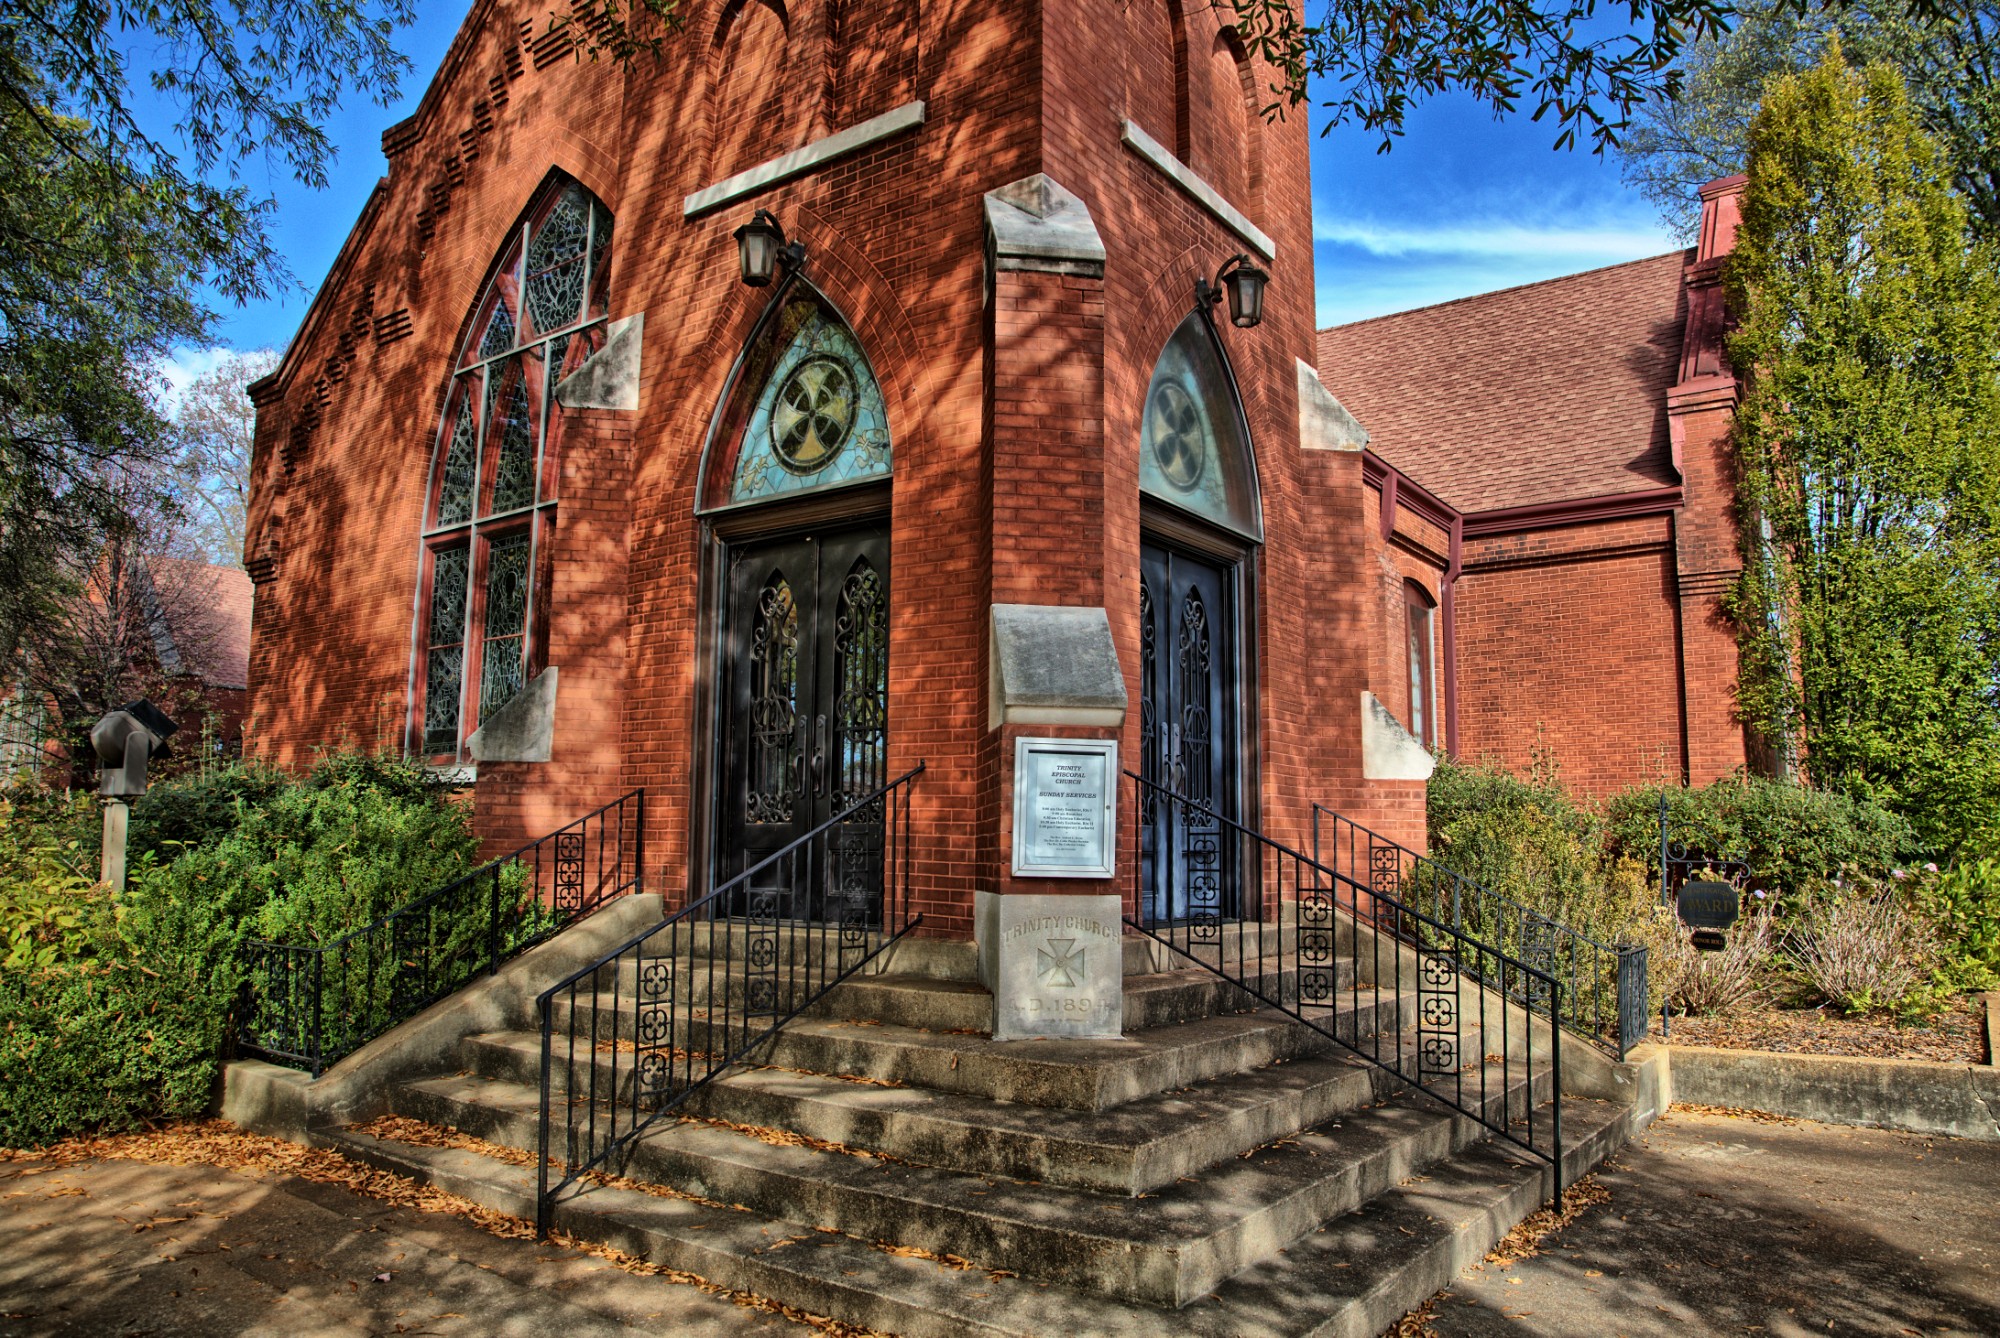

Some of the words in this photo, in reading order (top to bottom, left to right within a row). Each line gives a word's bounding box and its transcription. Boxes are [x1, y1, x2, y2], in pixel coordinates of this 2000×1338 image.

[1684, 899, 1733, 912] AWARD
[1005, 915, 1061, 942] TRINITY
[1066, 915, 1121, 944] CHURCH
